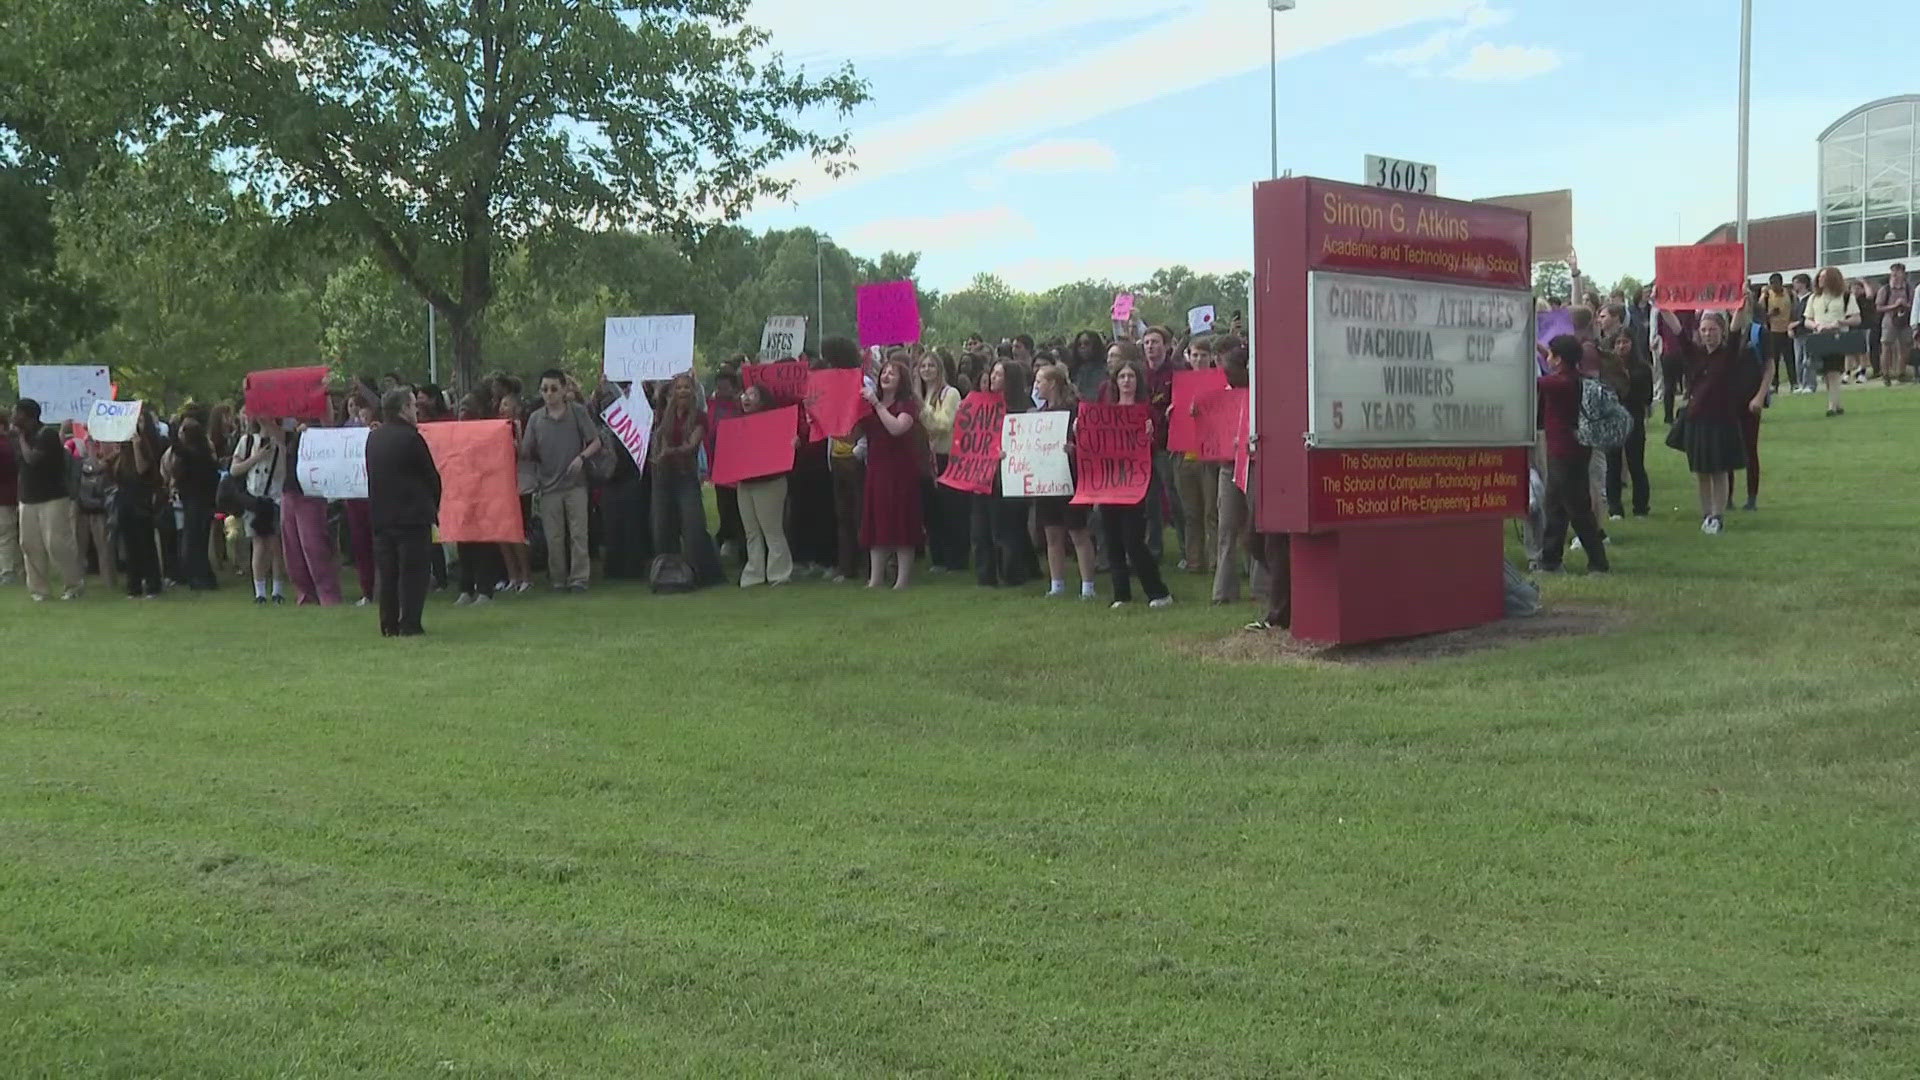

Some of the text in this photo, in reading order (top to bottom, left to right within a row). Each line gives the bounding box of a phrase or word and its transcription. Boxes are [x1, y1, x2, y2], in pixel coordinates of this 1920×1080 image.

[1376, 157, 1429, 193] 3605
[1323, 193, 1469, 240] Simon G. Atkins
[1322, 234, 1520, 274] Academic and Technology High School
[1329, 286, 1514, 329] CONGRATS ATHLETES
[1346, 327, 1495, 362] WACHOVIA CUP
[1383, 366, 1454, 397] WINNERS
[960, 402, 1004, 432] SAVE
[1332, 400, 1505, 431] 5 YEARS STRAIGHT
[961, 432, 993, 456] OUR
[1079, 427, 1149, 454] CUTTING
[1080, 455, 1149, 492] FUTURES
[1341, 452, 1503, 470] The School of Biotechnology at Atkins
[1024, 474, 1072, 495] Education
[1322, 472, 1517, 493] The School of Computer Technology at Atkins
[1336, 493, 1507, 516] The School of Pre-Engineering at Atkins
